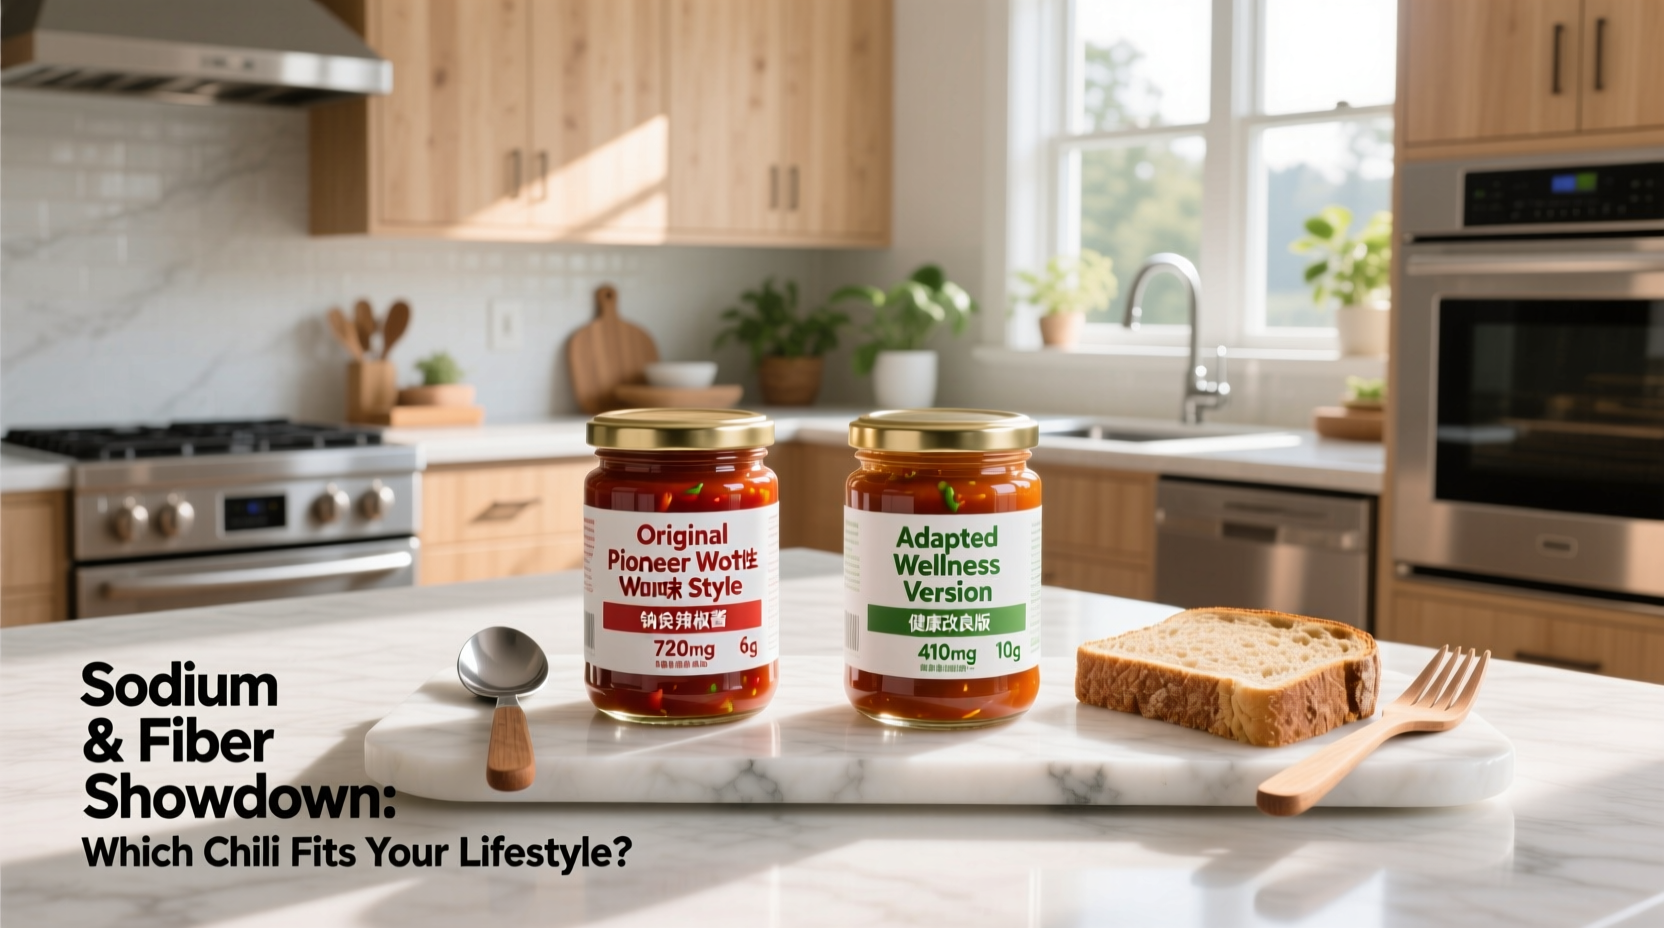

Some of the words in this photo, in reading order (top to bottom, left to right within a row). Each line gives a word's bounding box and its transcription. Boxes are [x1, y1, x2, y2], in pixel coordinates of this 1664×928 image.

[636, 522, 728, 551] Original
[896, 525, 998, 555] Adapted
[608, 548, 691, 572] Pioneer
[893, 553, 1000, 576] Wellness
[688, 576, 743, 602] Style
[904, 580, 992, 602] Version
[909, 613, 990, 633] 健康改良版
[654, 640, 715, 660] 720mg
[739, 636, 758, 657] 6g
[918, 643, 977, 665] 410mg
[996, 641, 1021, 662] 10g
